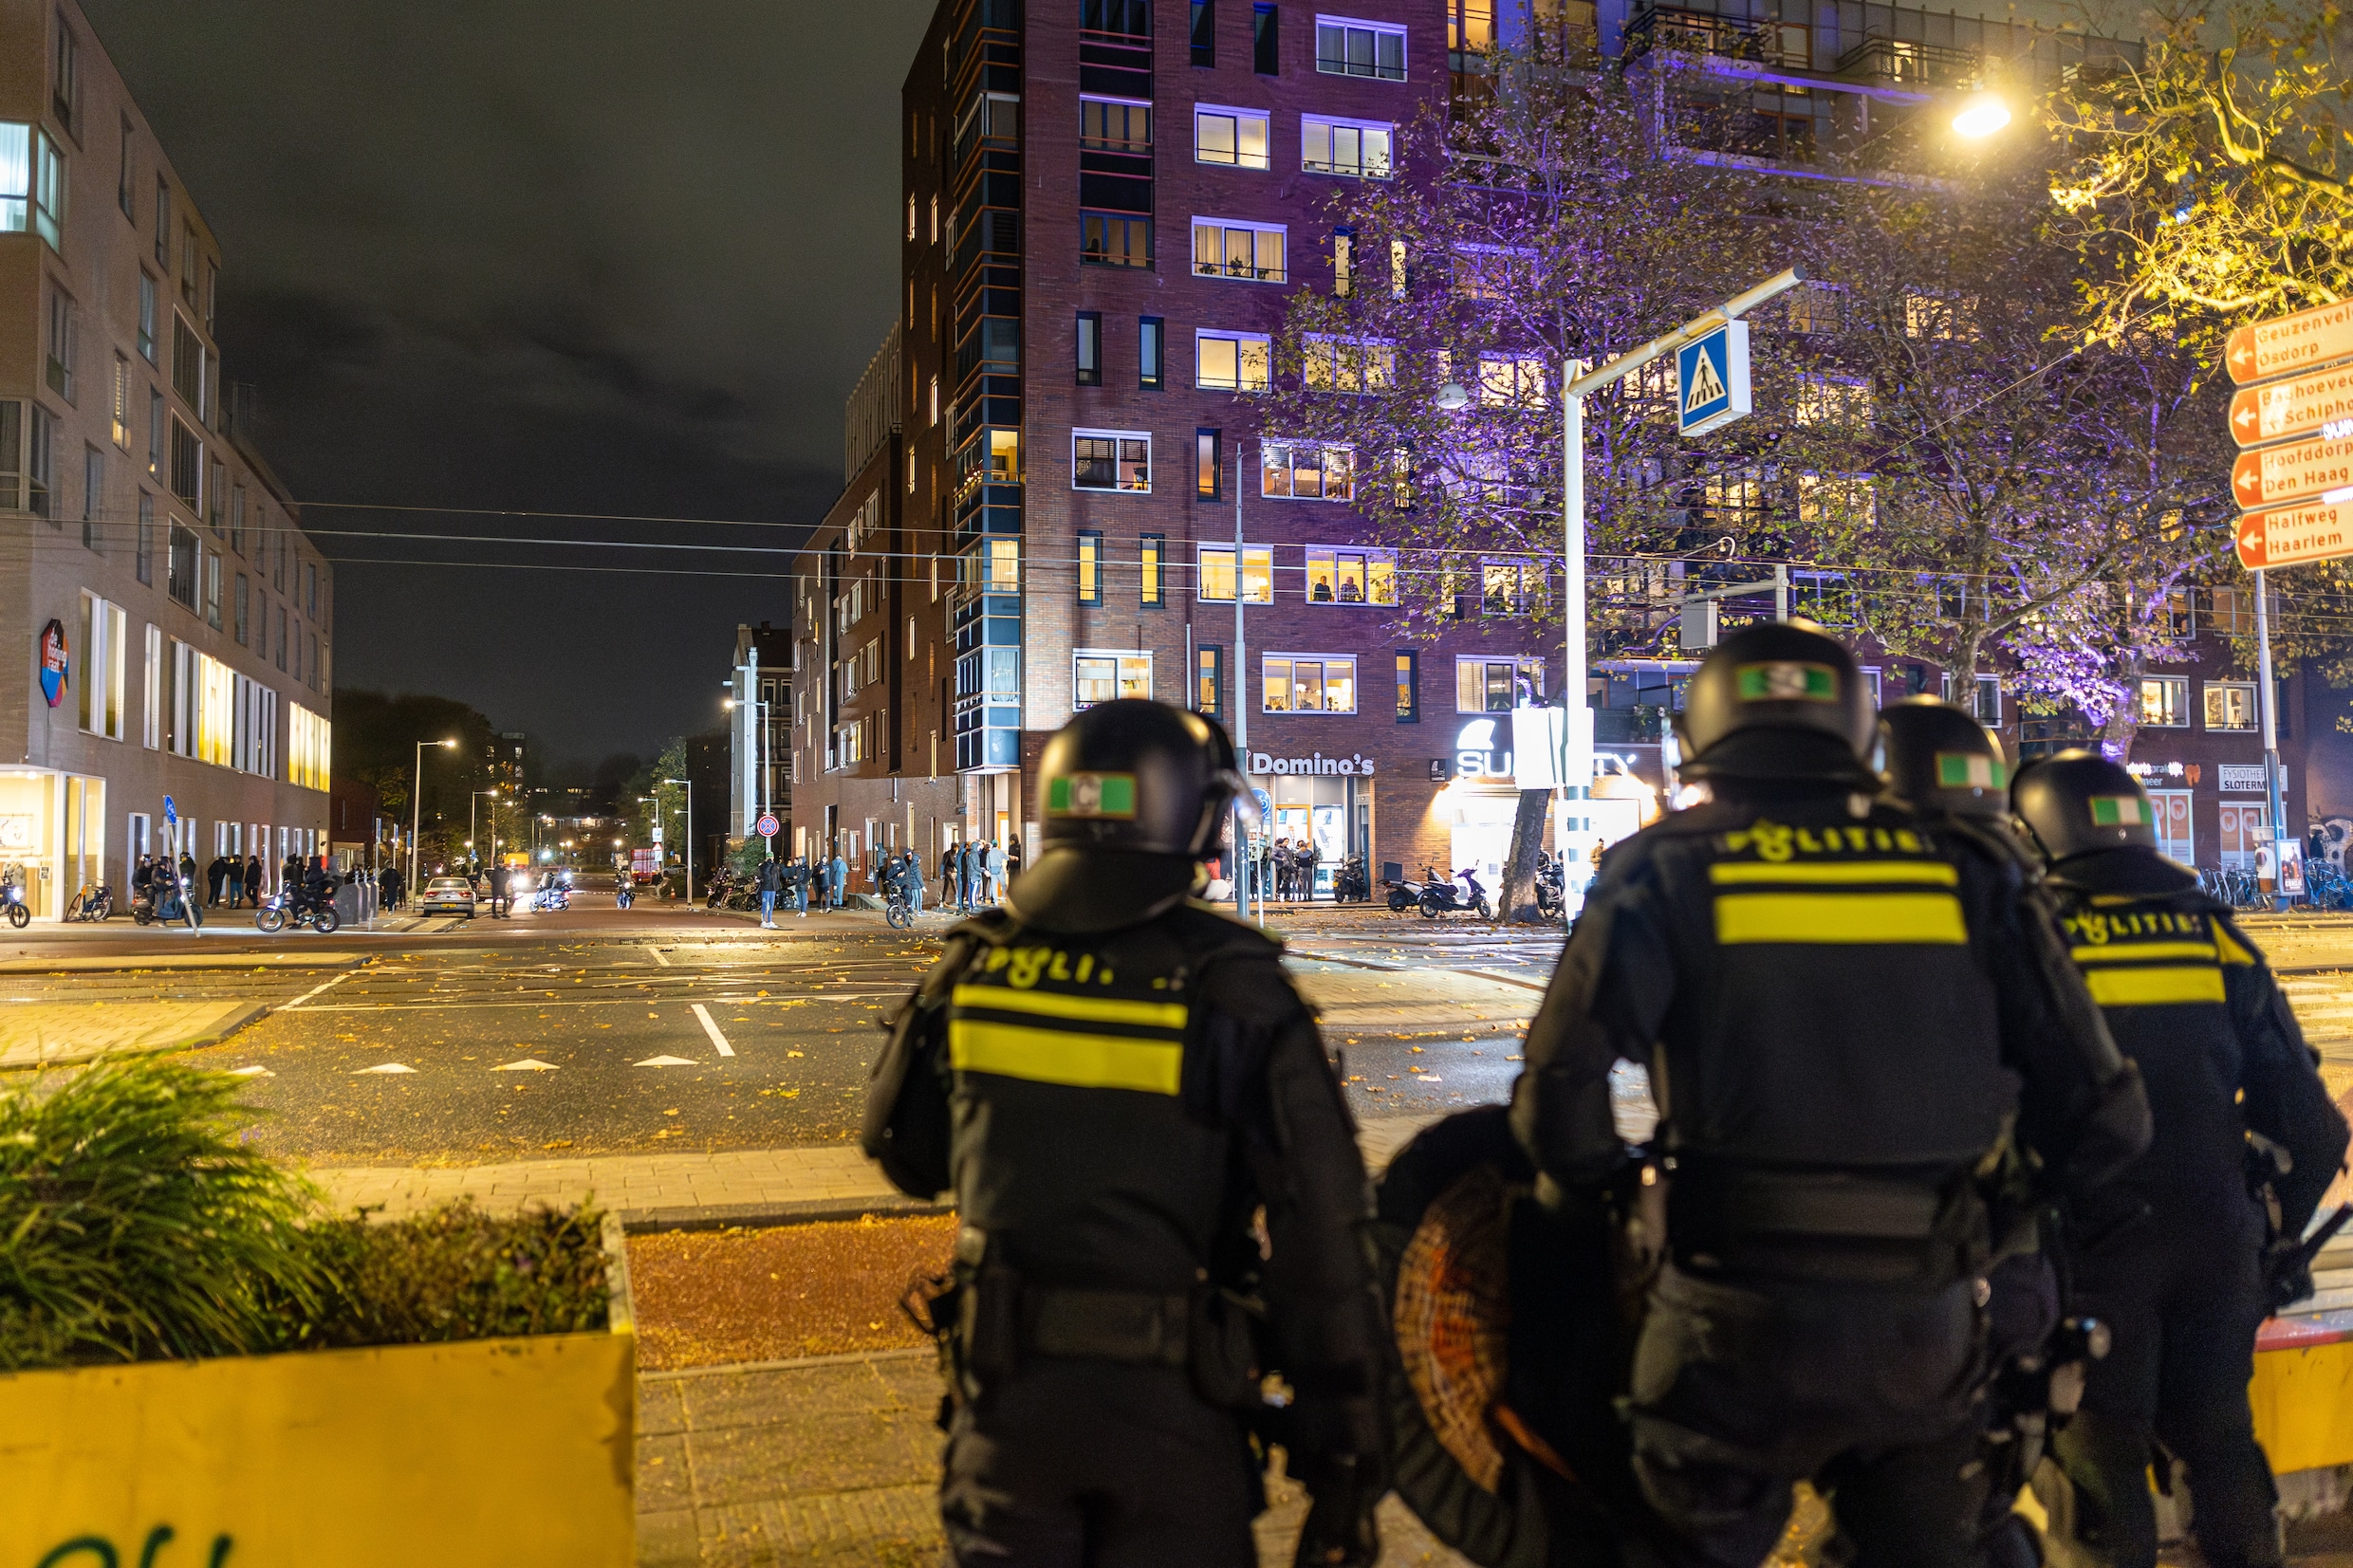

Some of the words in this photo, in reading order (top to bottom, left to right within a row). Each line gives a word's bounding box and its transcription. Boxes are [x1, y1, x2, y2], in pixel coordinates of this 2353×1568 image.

[2258, 305, 2353, 343] Geuzenvel
[2259, 342, 2319, 366] Osdorp
[2264, 441, 2353, 469] Hoofddorp
[2265, 476, 2296, 493] Den
[2305, 467, 2348, 486] Haag
[2269, 509, 2338, 530] Halfweg
[2270, 532, 2343, 554] Haarlem
[1252, 751, 1375, 776] Domino's
[1456, 751, 1637, 777] SUTY
[2223, 769, 2266, 780] FYSIOTHER
[2224, 780, 2267, 790] SLOTERM
